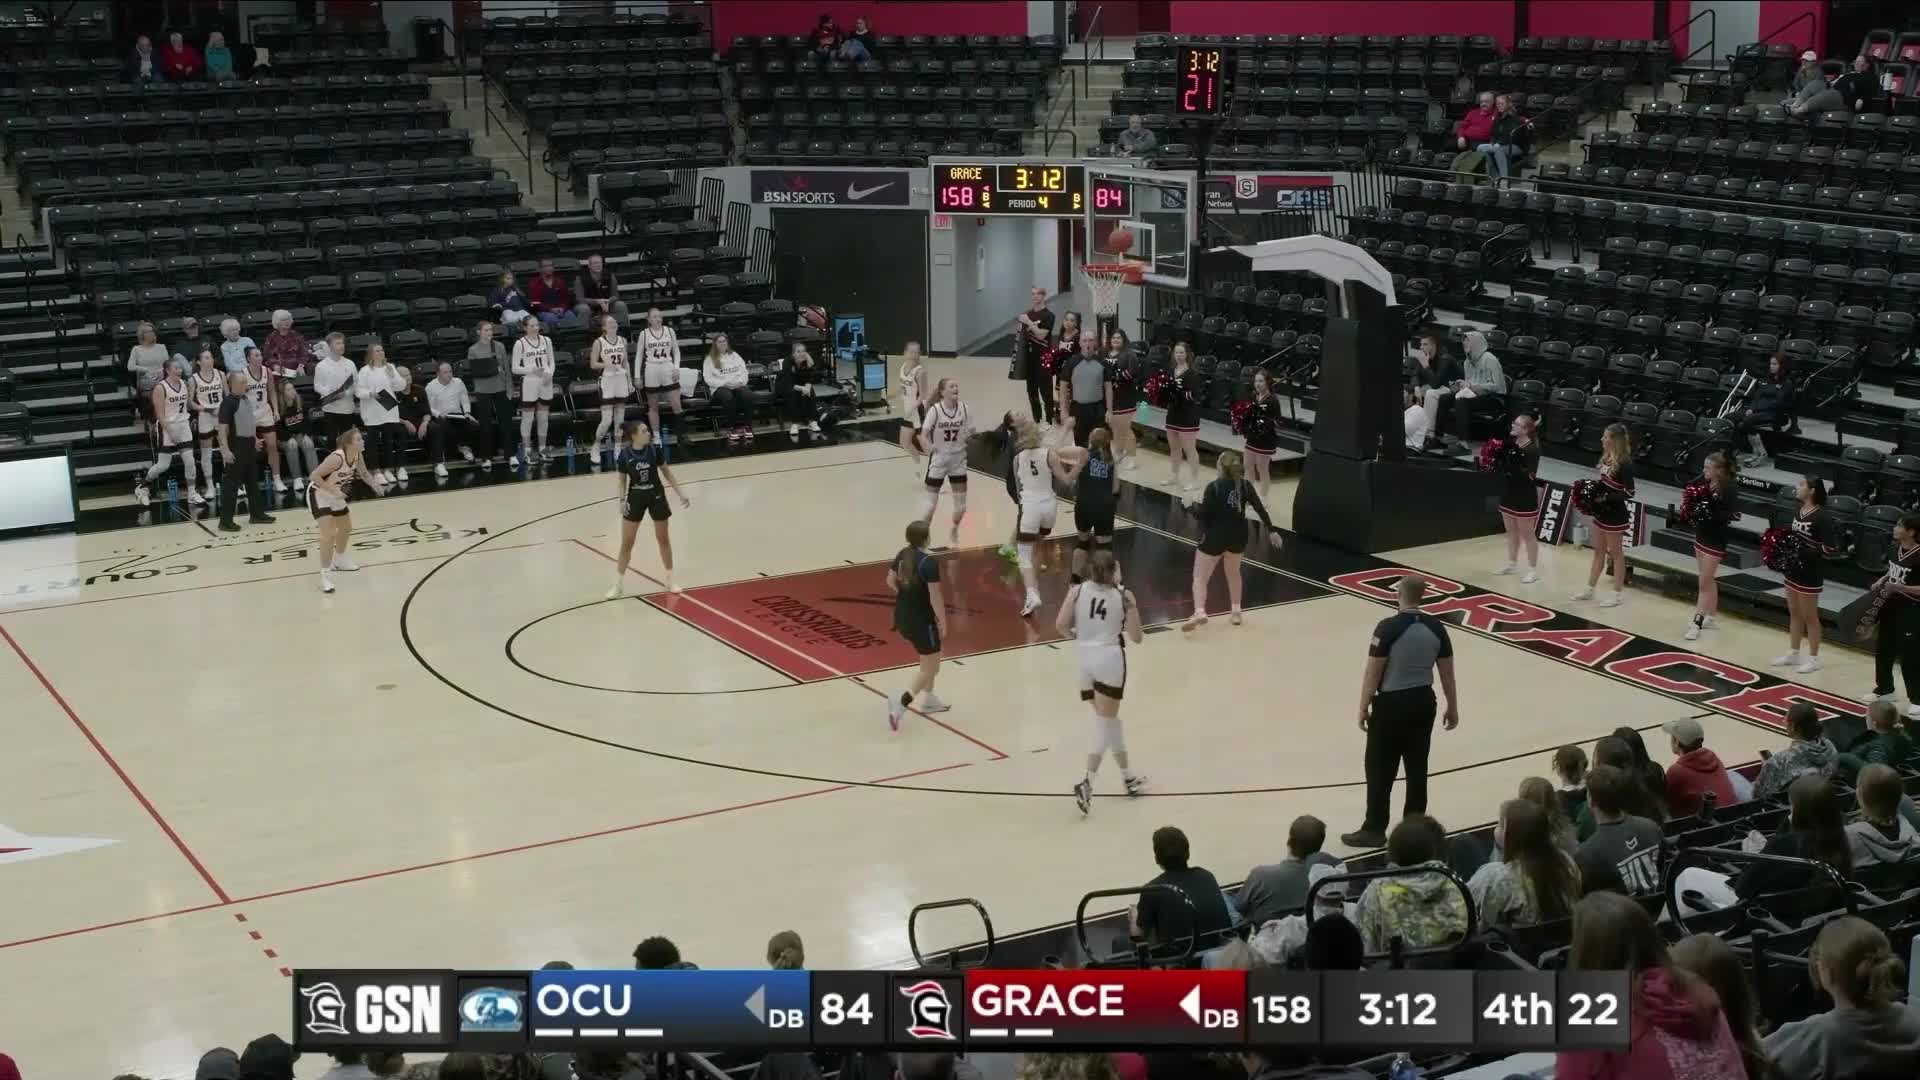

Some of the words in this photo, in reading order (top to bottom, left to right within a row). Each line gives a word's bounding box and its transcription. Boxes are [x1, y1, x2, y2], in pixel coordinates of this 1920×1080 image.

[1190, 51, 1219, 72] 3:12
[1184, 74, 1213, 110] 21
[950, 167, 982, 180] GRACE
[1016, 169, 1061, 189] 3:12
[942, 187, 973, 206] 158
[1008, 199, 1036, 208] PERIOD
[1038, 196, 1048, 208] 4
[1096, 188, 1122, 208] 84
[535, 357, 543, 367] 11
[610, 355, 622, 365] 25
[653, 349, 667, 359] 44
[208, 392, 219, 404] 15
[1030, 460, 1039, 476] 5
[1539, 489, 1564, 542] BLACK
[242, 527, 488, 565] KESSER
[1089, 597, 1107, 620] 14
[744, 607, 829, 645] LEAGUE
[751, 595, 888, 649] CROSSROADS
[1328, 567, 1868, 737] GRACE
